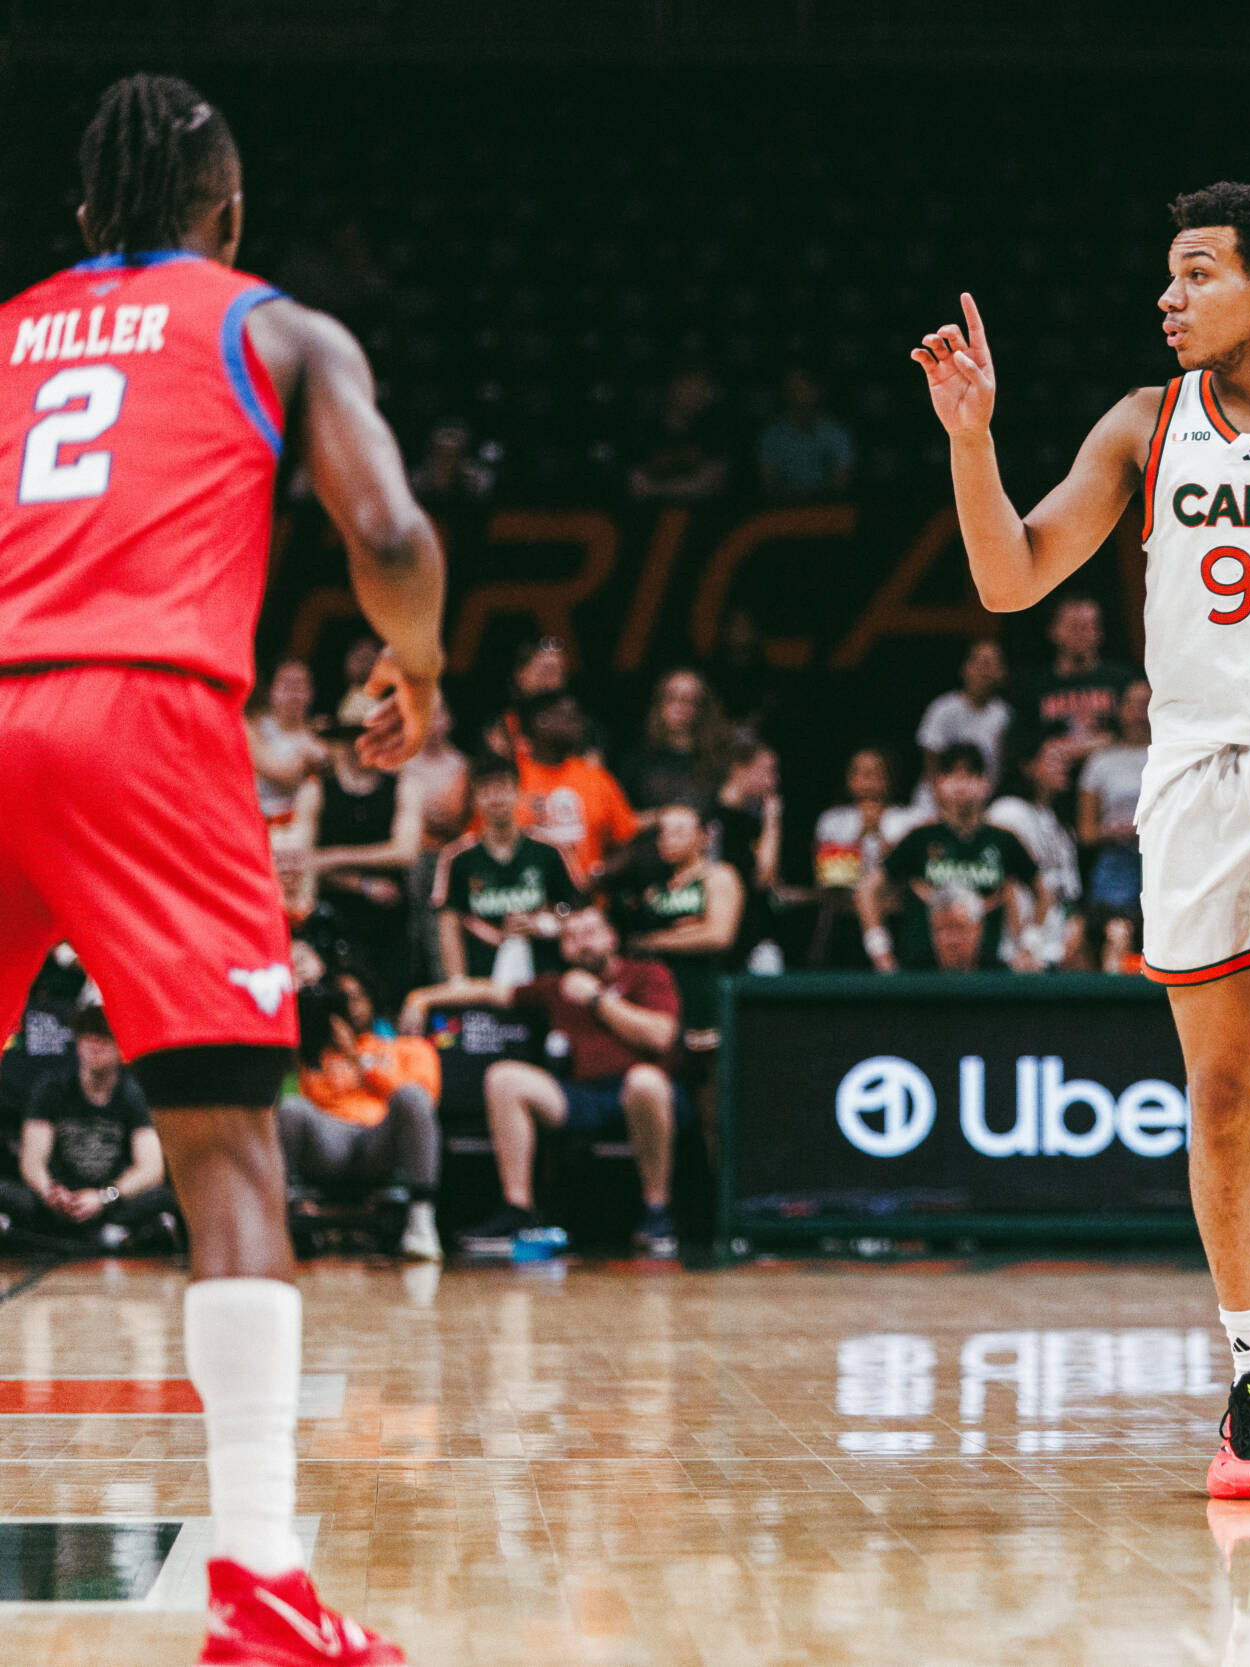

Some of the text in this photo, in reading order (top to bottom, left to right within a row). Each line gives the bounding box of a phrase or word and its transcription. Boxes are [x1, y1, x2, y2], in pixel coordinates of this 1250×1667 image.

[9, 303, 170, 366] MILLER
[17, 363, 128, 507] 2
[1191, 431, 1211, 441] 100
[959, 1054, 1190, 1158] Ube
